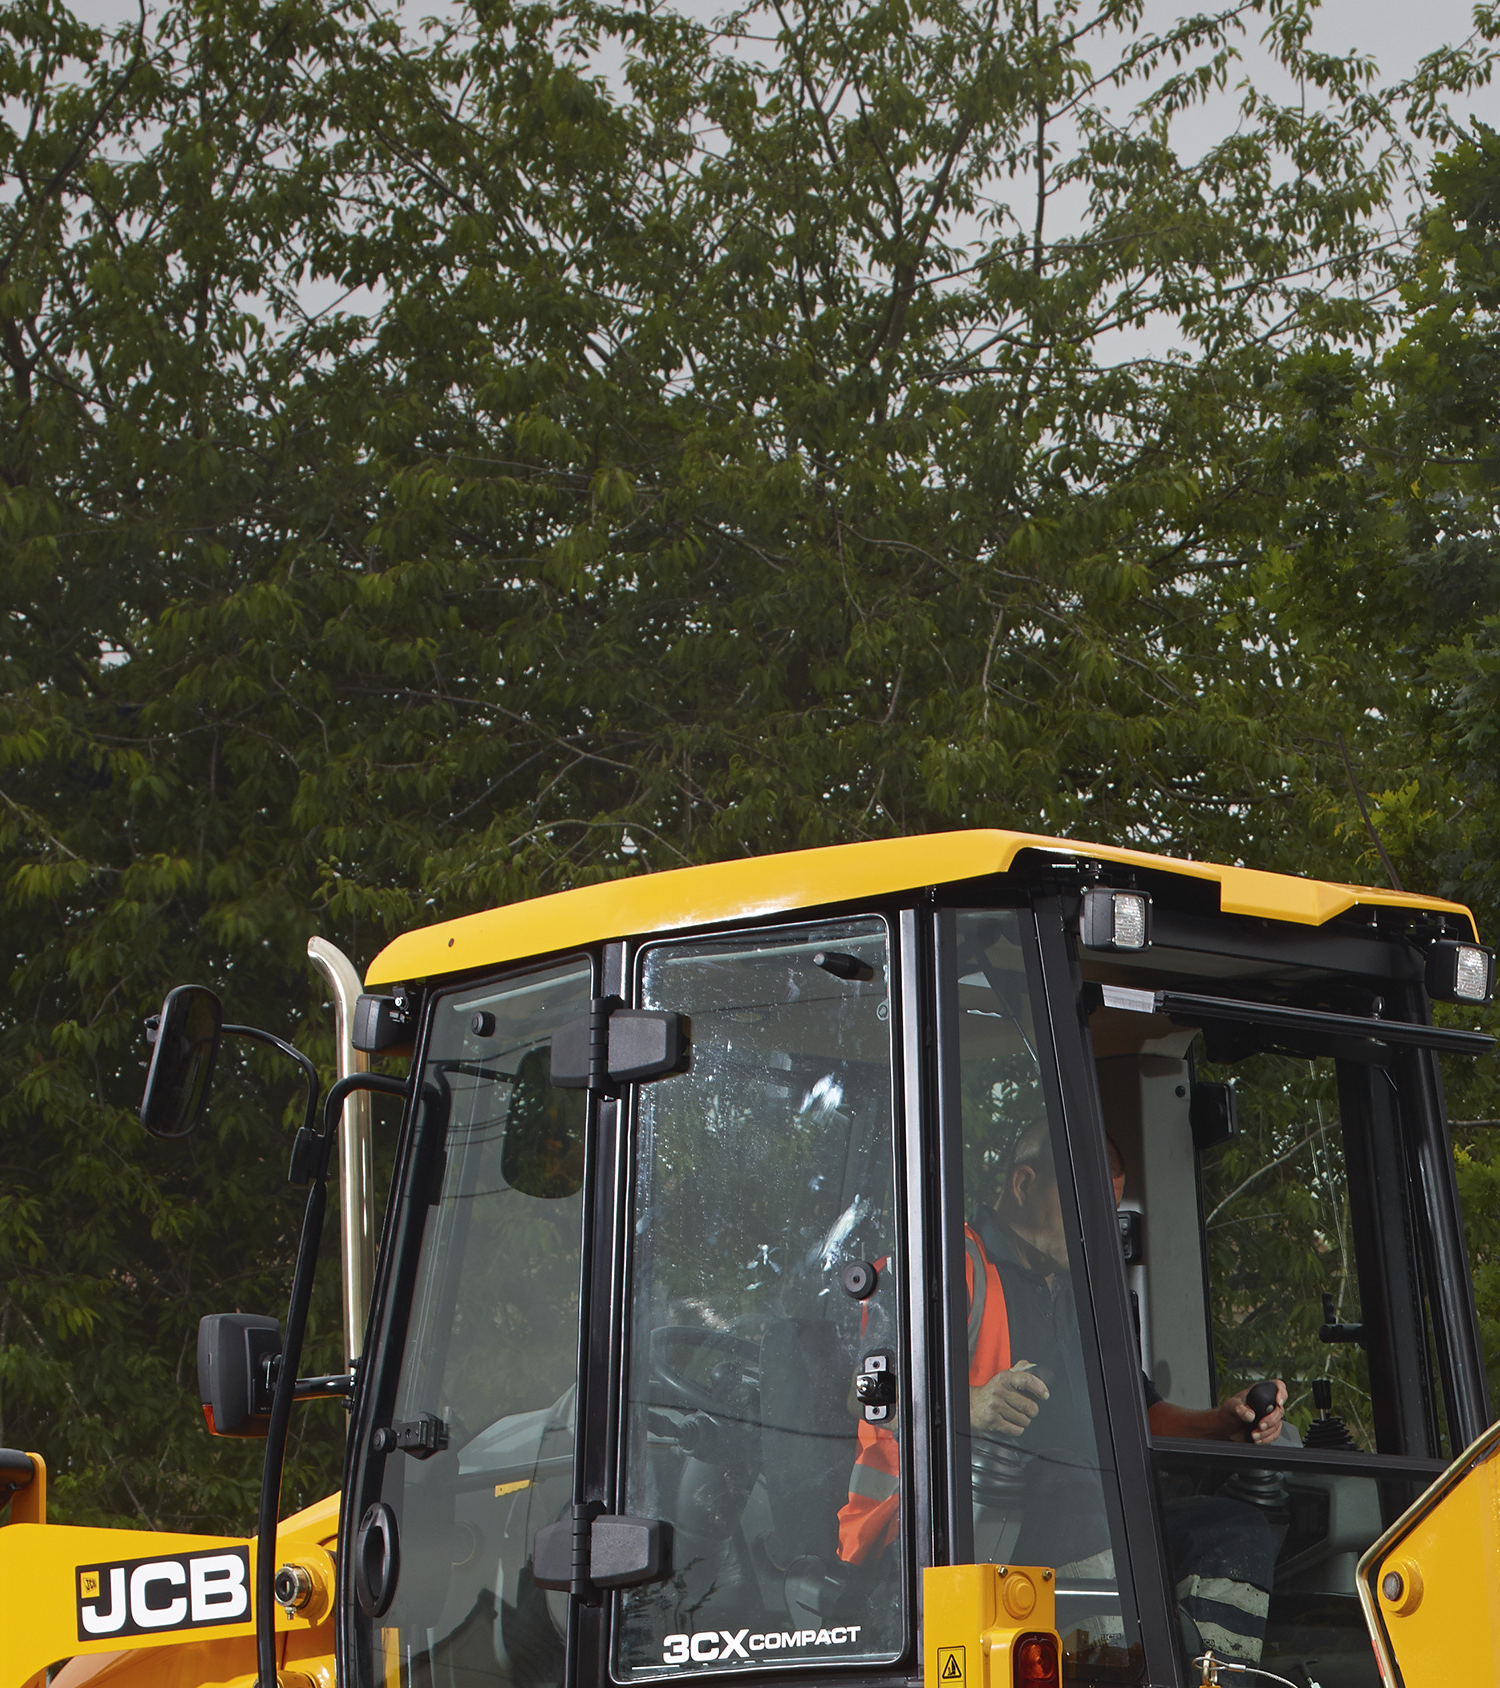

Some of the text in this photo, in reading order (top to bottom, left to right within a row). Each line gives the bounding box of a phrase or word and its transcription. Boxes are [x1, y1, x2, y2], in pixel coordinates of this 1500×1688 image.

[81, 1554, 248, 1634] JCB
[662, 1625, 862, 1664] 3CX COMPACT
